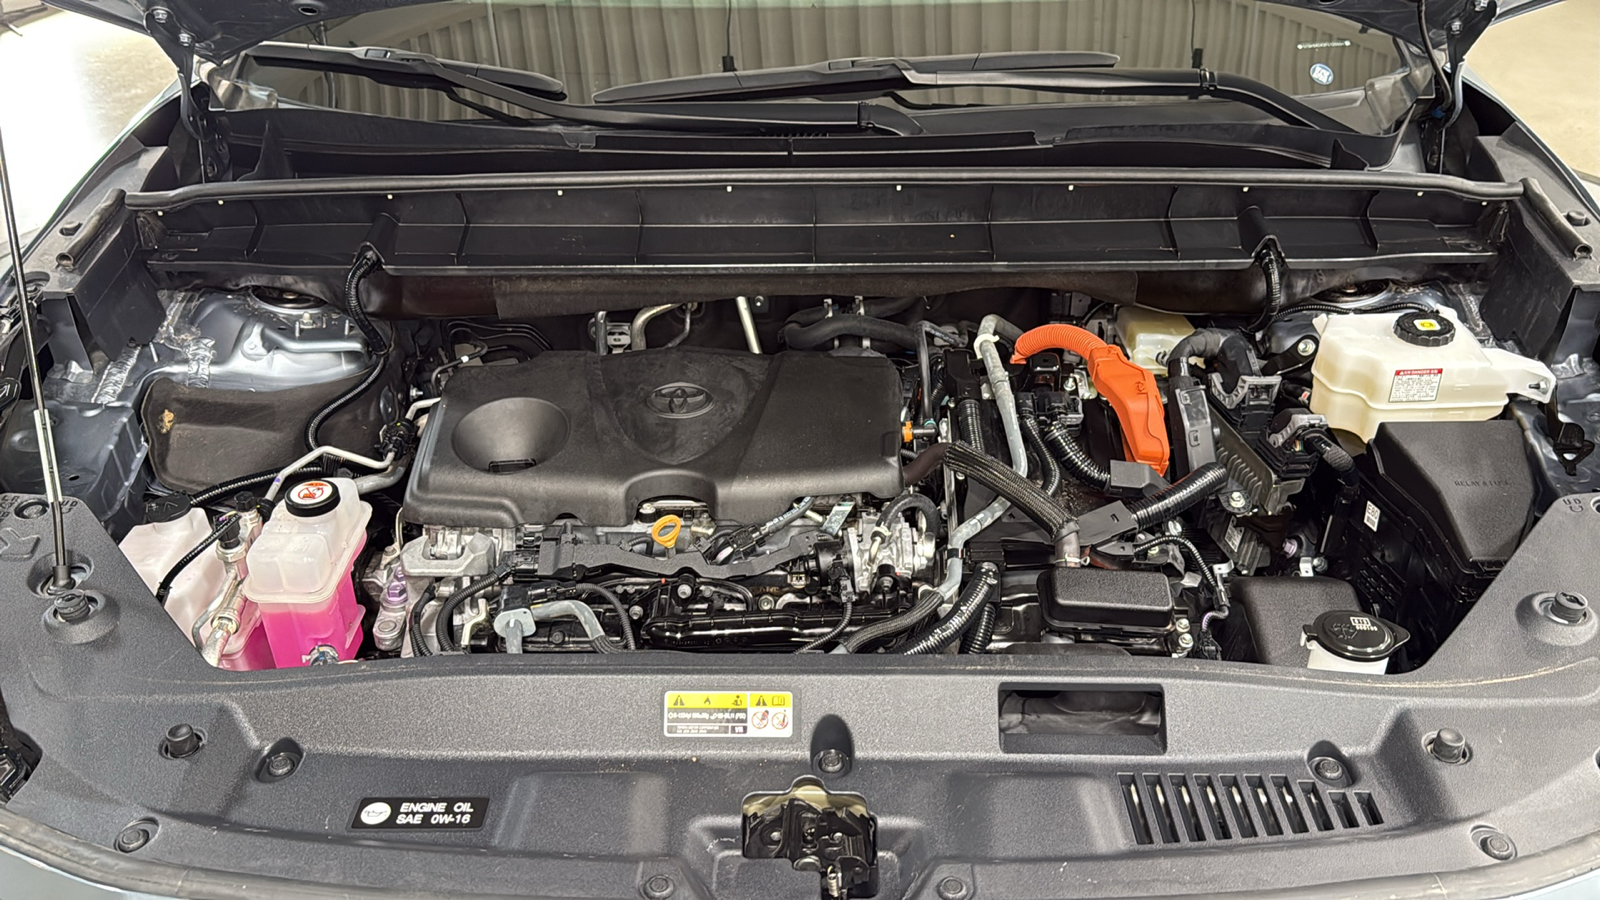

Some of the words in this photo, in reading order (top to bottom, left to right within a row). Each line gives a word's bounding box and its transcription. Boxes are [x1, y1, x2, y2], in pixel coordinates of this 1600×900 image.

[400, 802, 447, 812] ENGINE
[453, 802, 474, 812] OIL
[396, 814, 423, 824] SAE
[431, 814, 470, 824] 0W-16
